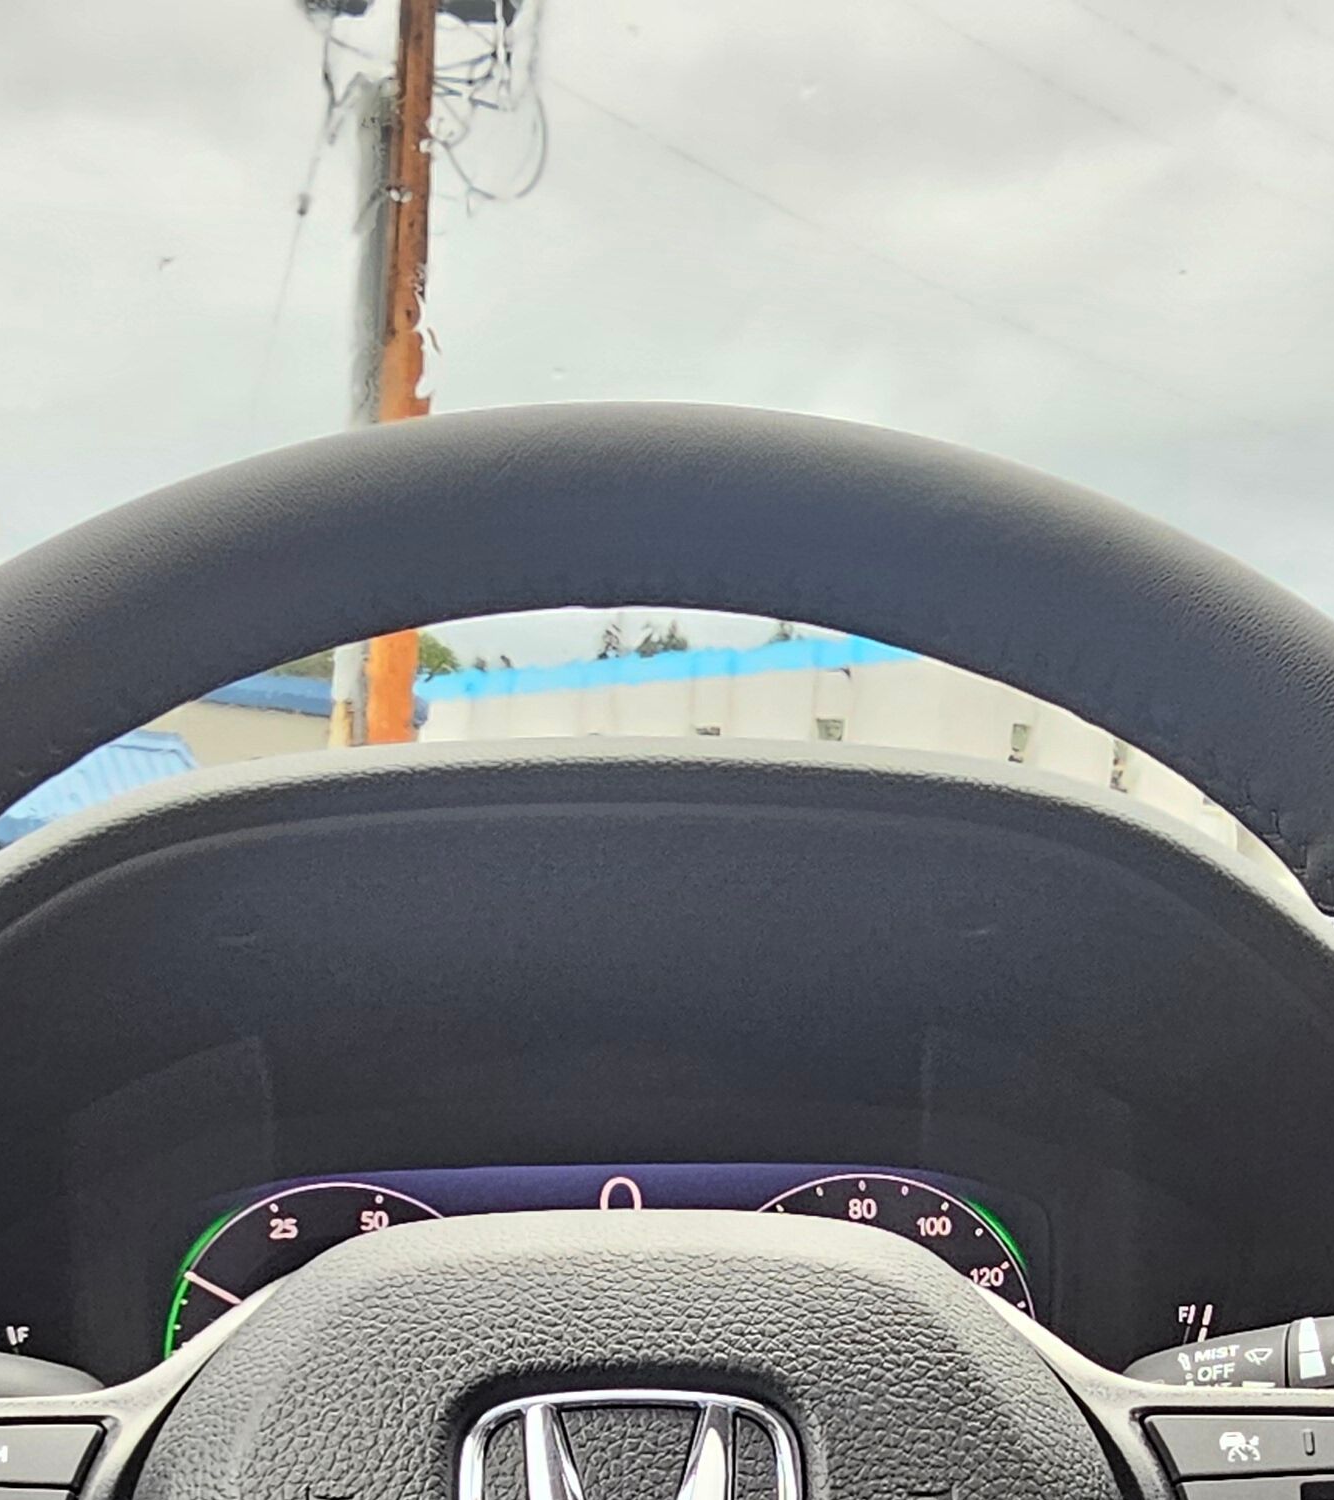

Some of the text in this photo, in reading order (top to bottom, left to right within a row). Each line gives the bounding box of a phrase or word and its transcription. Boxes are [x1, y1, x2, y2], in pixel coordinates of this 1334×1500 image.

[848, 1198, 878, 1220] 80
[269, 1218, 299, 1240] 25
[360, 1210, 389, 1231] 50
[917, 1216, 952, 1237] 100
[970, 1267, 1005, 1287] 120
[1194, 1344, 1240, 1363] MIST
[1197, 1362, 1236, 1382] OFF
